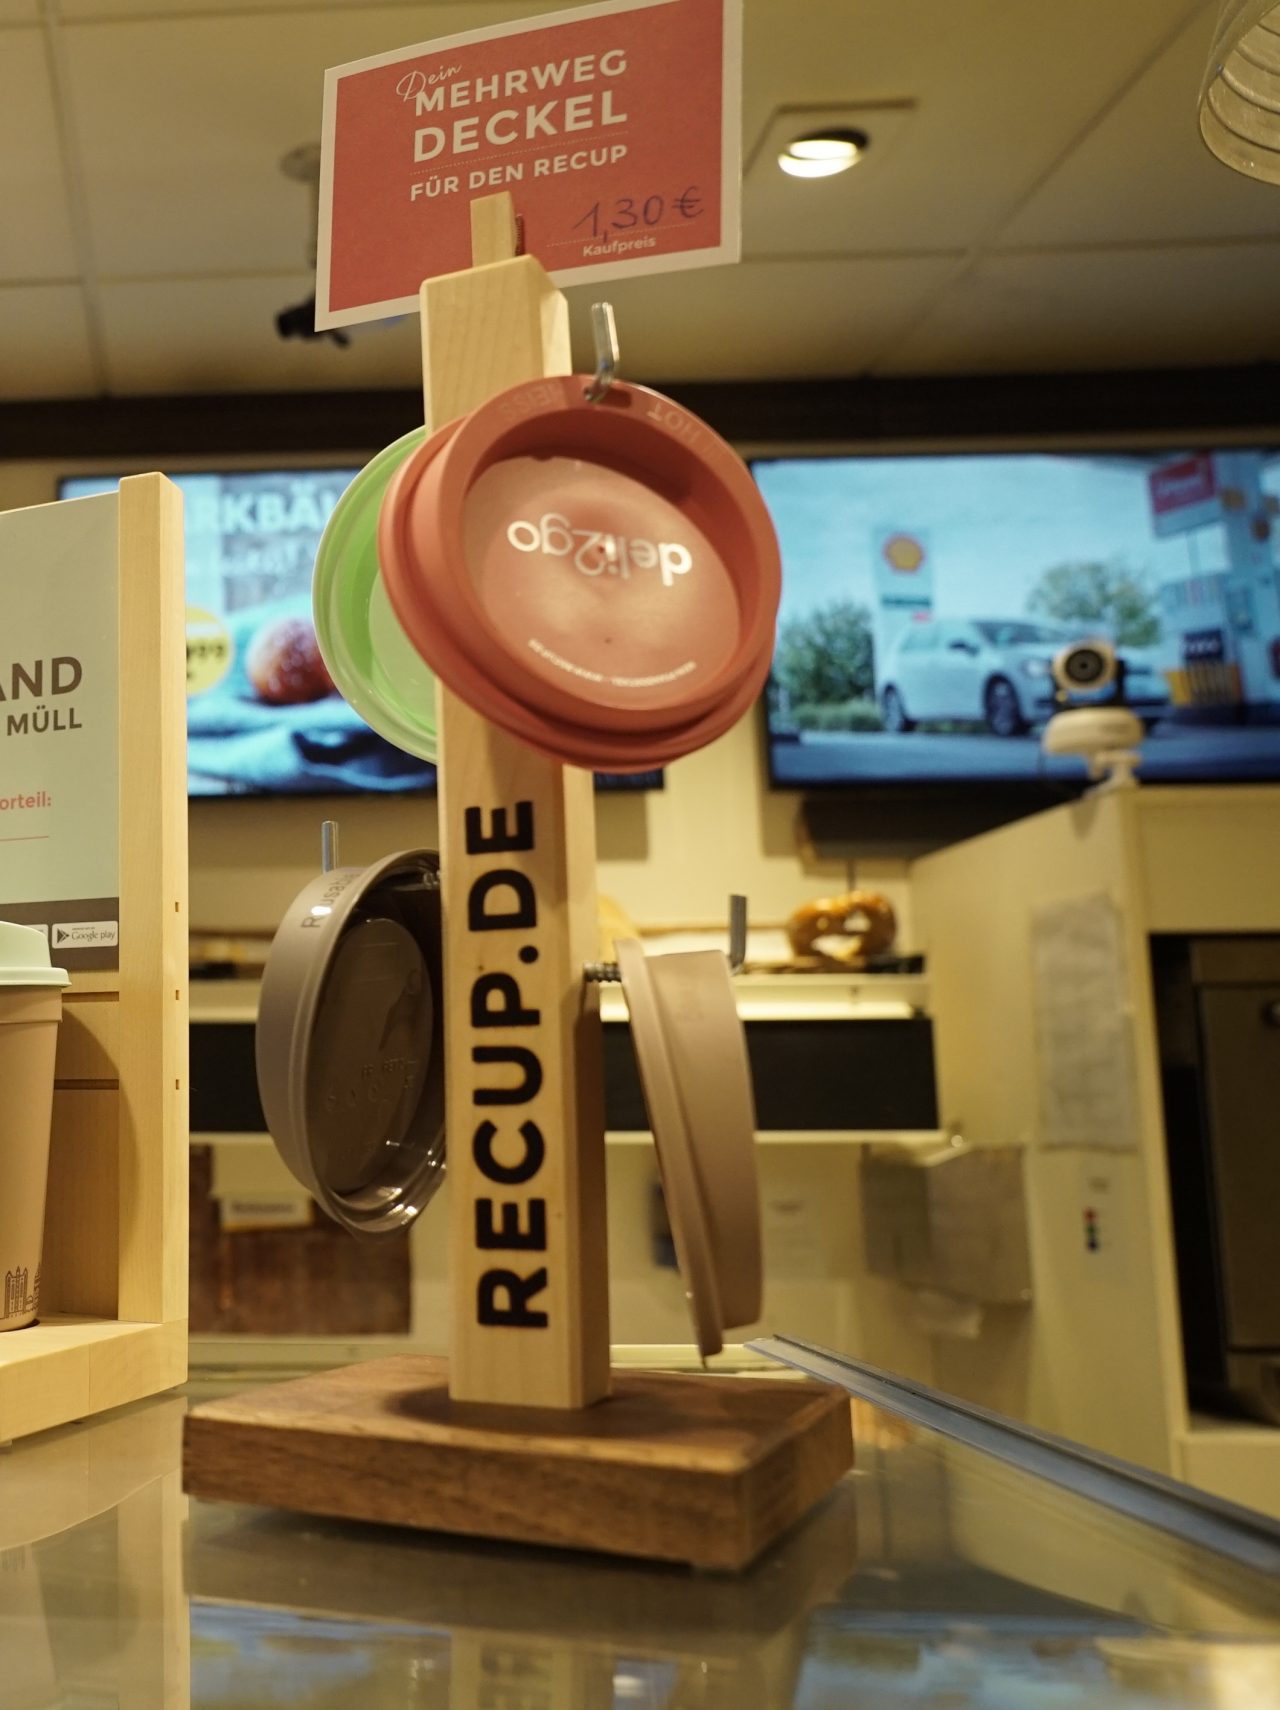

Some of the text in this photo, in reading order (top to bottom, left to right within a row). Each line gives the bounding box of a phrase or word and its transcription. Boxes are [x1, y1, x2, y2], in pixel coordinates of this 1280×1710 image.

[396, 63, 462, 101] Dein
[414, 49, 628, 117] MEHRWEG
[413, 90, 628, 163] DECKEL
[410, 145, 628, 201] FÜR DEN RECUP
[583, 235, 656, 258] Kaufpreis
[507, 512, 693, 587] deli2go
[7, 705, 82, 736] MÜLL
[71, 930, 115, 942] Google play
[465, 801, 549, 1330] RECUP.DE
